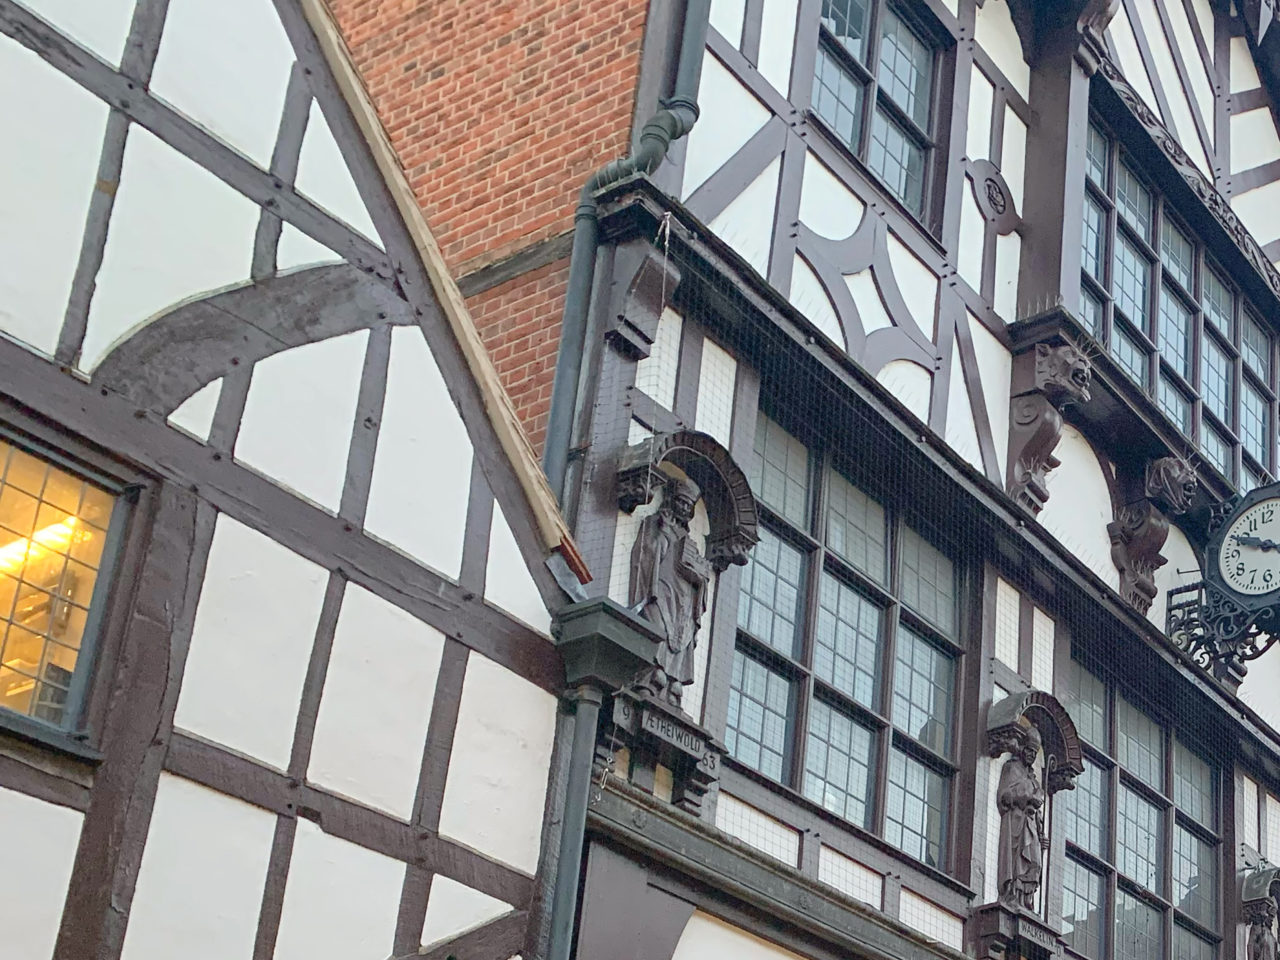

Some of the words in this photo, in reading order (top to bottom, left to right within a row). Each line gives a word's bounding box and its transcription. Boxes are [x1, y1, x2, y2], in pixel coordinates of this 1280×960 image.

[1261, 509, 1274, 524] 12
[1249, 518, 1258, 532] 11
[1231, 549, 1241, 562] 9
[1236, 562, 1245, 576] 8
[1263, 569, 1273, 583] 6
[1249, 569, 1258, 584] 7
[702, 751, 716, 770] 63
